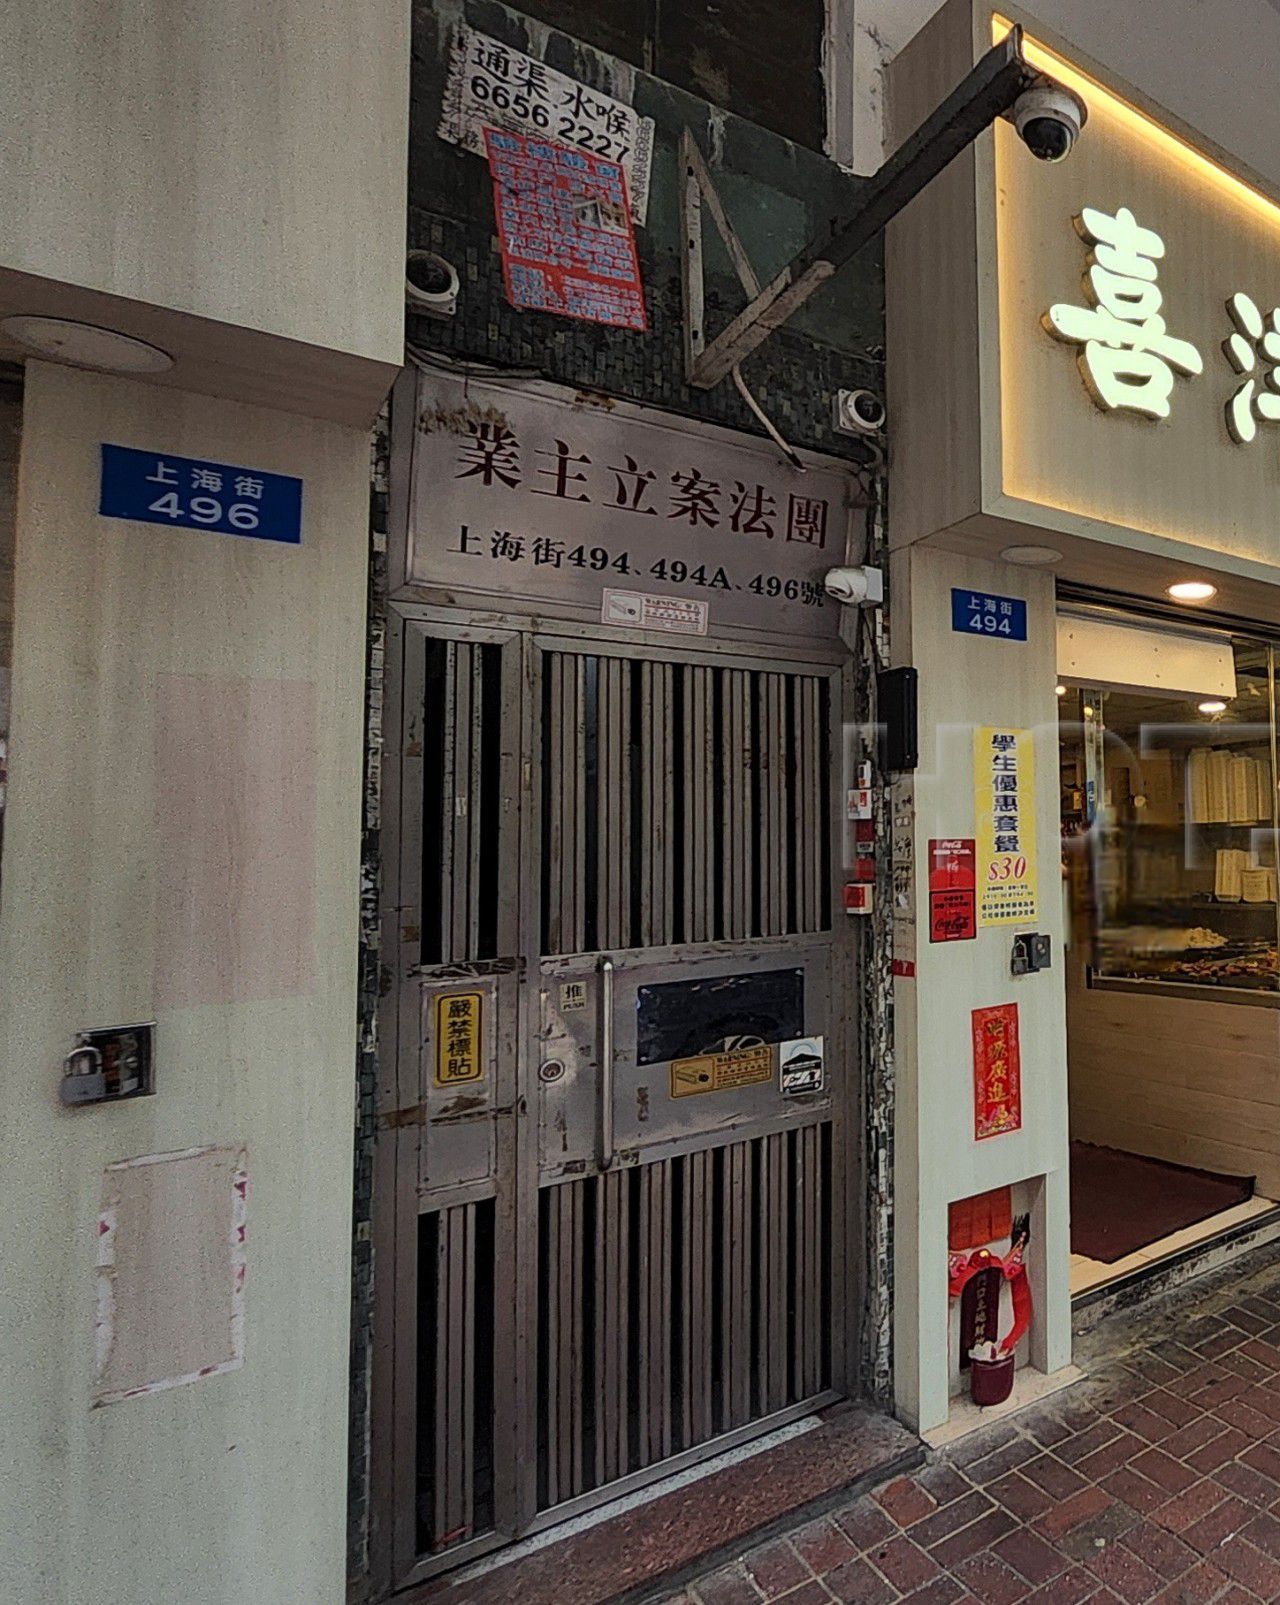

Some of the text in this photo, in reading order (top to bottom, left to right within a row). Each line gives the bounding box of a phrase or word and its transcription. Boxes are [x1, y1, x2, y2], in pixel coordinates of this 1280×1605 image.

[471, 75, 550, 128] 6656
[557, 116, 630, 163] 2227
[146, 462, 264, 499] 上海街
[455, 421, 829, 549] 業主立案法團
[148, 492, 259, 529] 496
[968, 596, 1012, 616] 上海街
[969, 614, 1011, 634] 494
[991, 734, 1020, 853] 學生優惠套餐
[566, 984, 582, 999] 推
[447, 1000, 473, 1078] 嚴禁標貼
